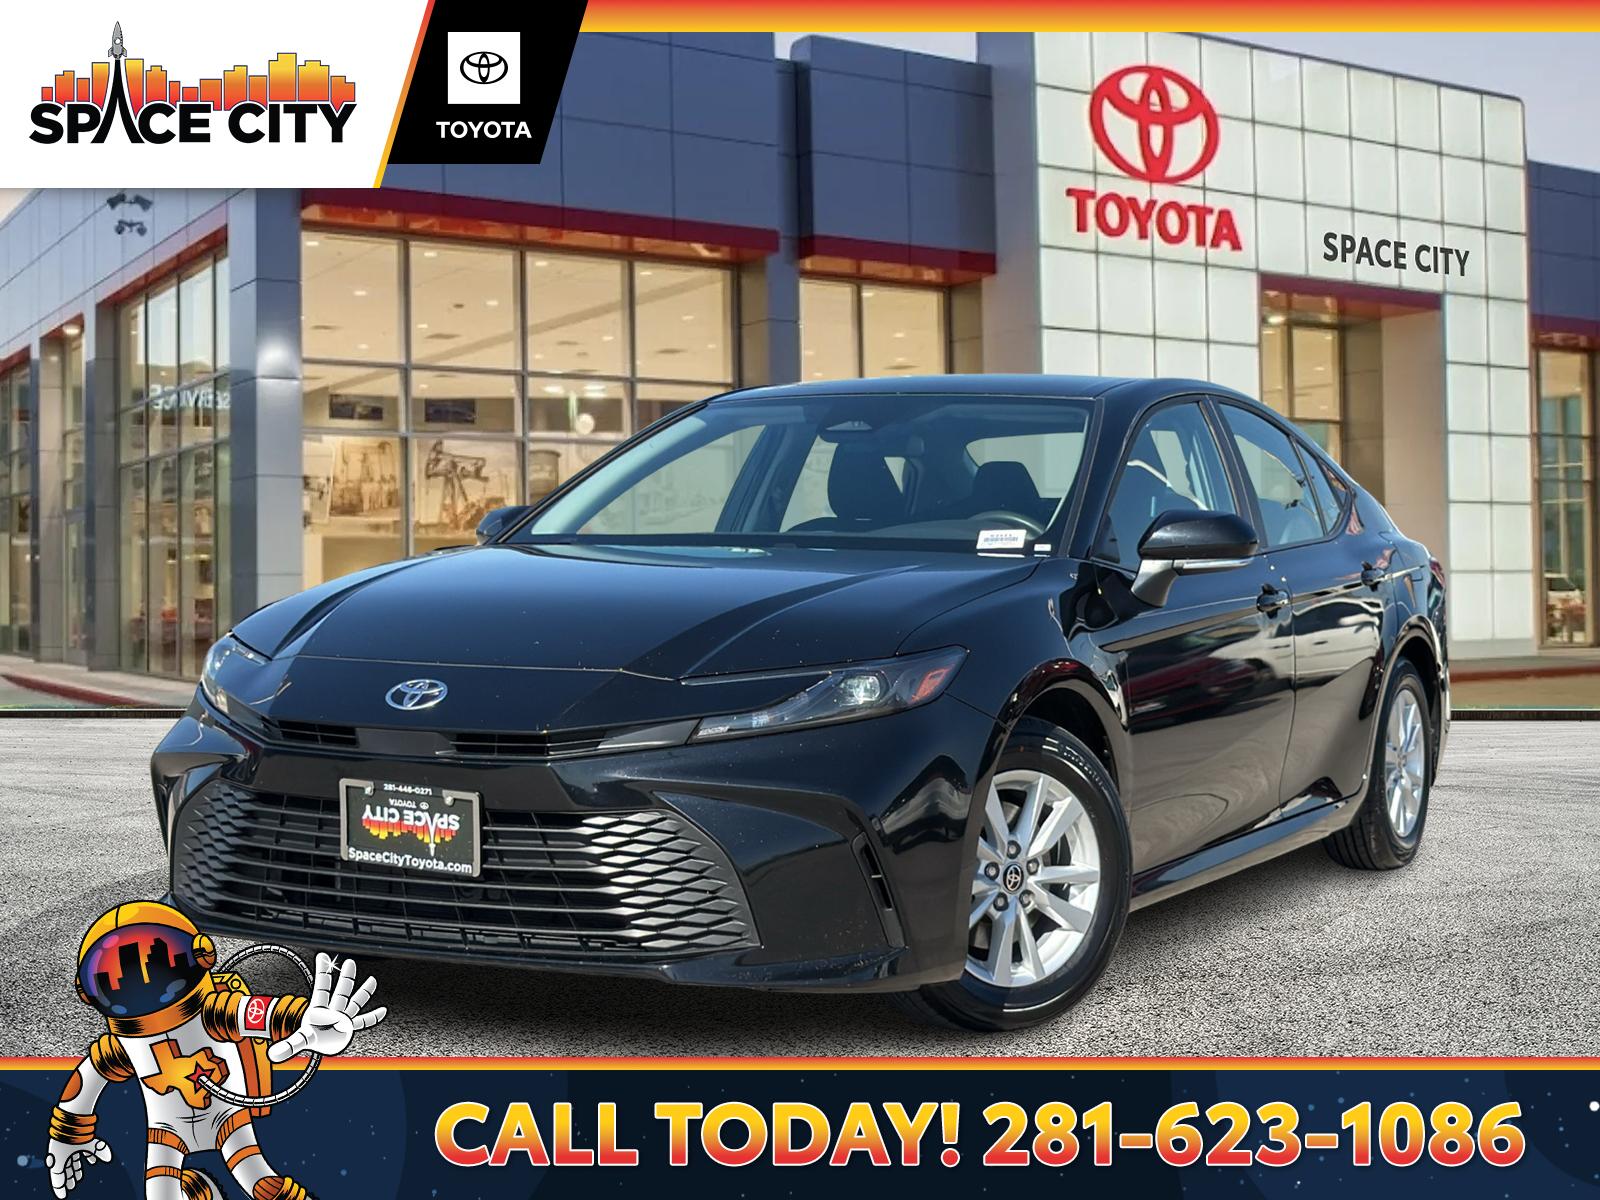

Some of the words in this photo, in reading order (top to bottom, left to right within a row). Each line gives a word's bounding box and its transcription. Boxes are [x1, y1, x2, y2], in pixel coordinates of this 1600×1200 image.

[1065, 187, 1242, 251] TOYOTA
[1323, 232, 1407, 270] SPACE
[1414, 244, 1470, 277] CITY
[362, 804, 400, 824] CITY
[388, 798, 417, 810] TOYOTA
[403, 809, 460, 834] SPACE
[348, 847, 472, 874] SpaceCityToyota.com
